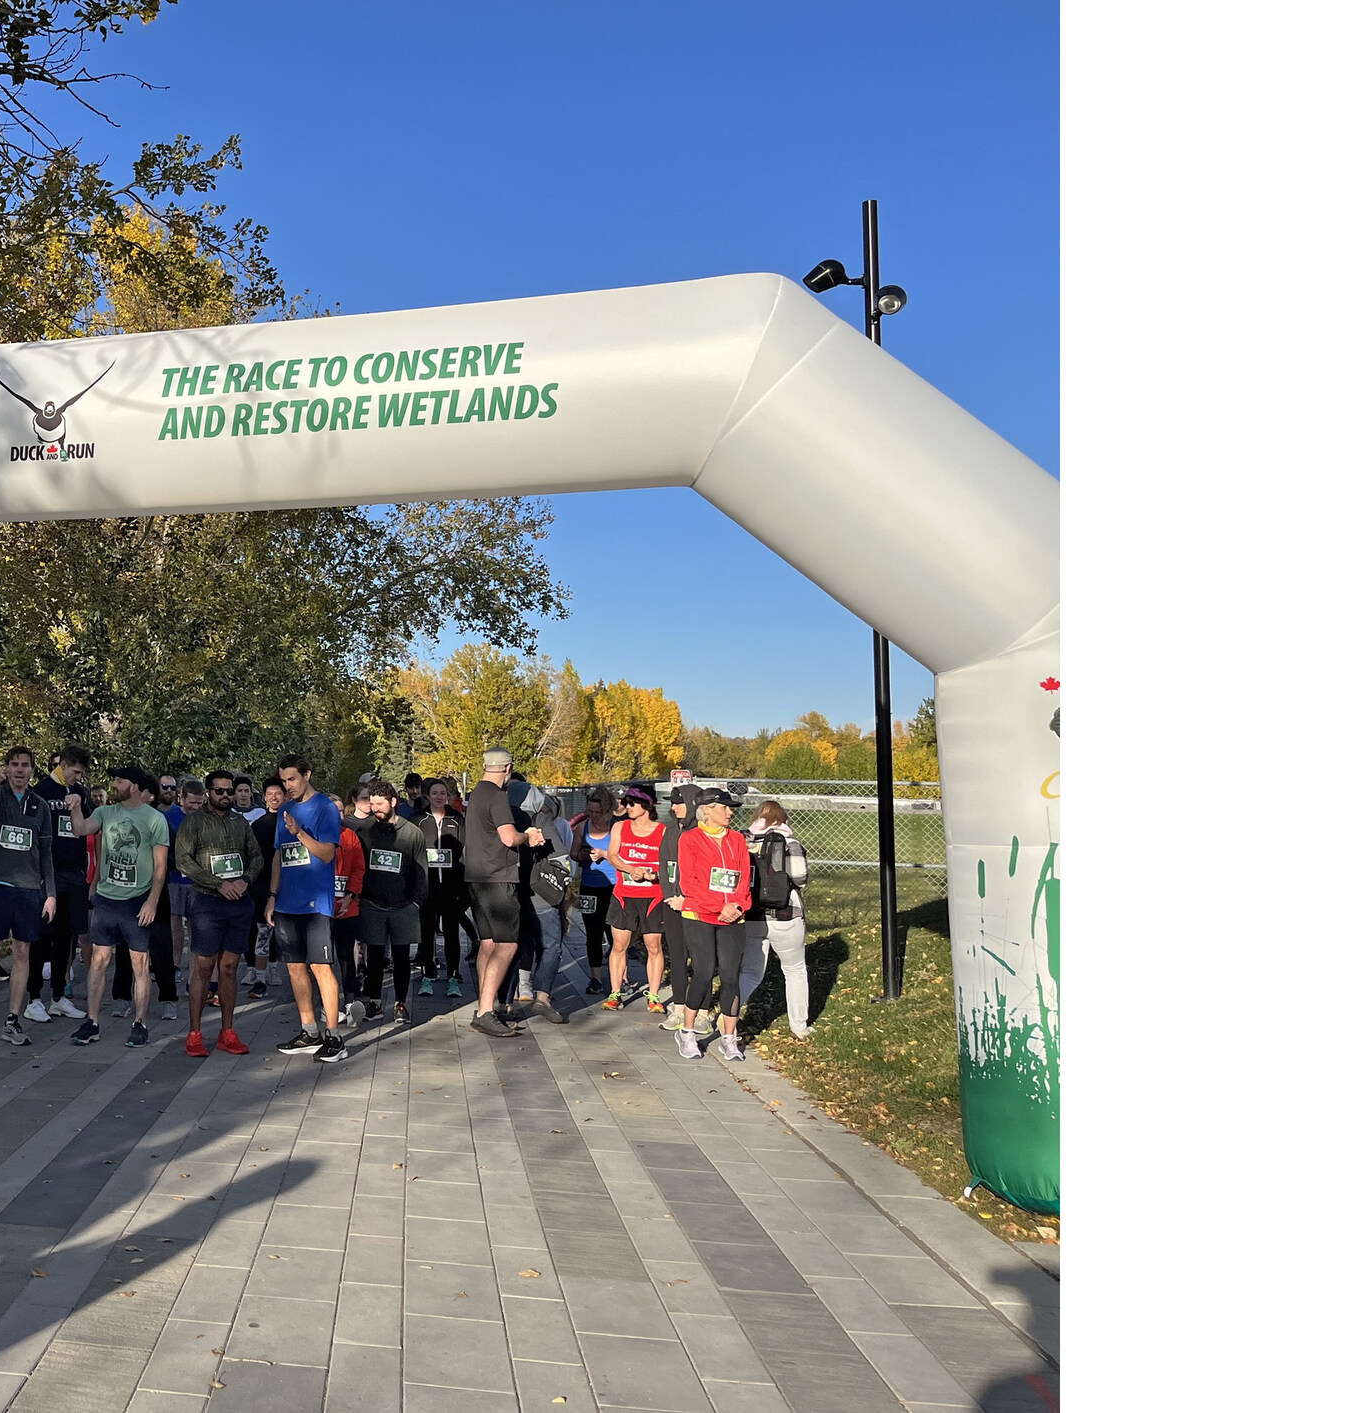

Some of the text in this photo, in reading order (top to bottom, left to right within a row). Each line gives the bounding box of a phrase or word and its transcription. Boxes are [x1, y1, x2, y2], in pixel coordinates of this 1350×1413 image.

[161, 342, 525, 398] THE RACE TO CONSERVE
[158, 382, 559, 441] AND RESTORE WETLANDS
[10, 443, 95, 462] DUCK AND RUN
[8, 831, 24, 844] 66
[285, 847, 300, 859] 44
[431, 853, 445, 862] 29
[628, 849, 647, 860] Bee
[224, 859, 233, 871] 1
[377, 854, 393, 865] 42
[113, 868, 128, 881] 51
[719, 873, 736, 886] 41
[334, 881, 347, 891] 37
